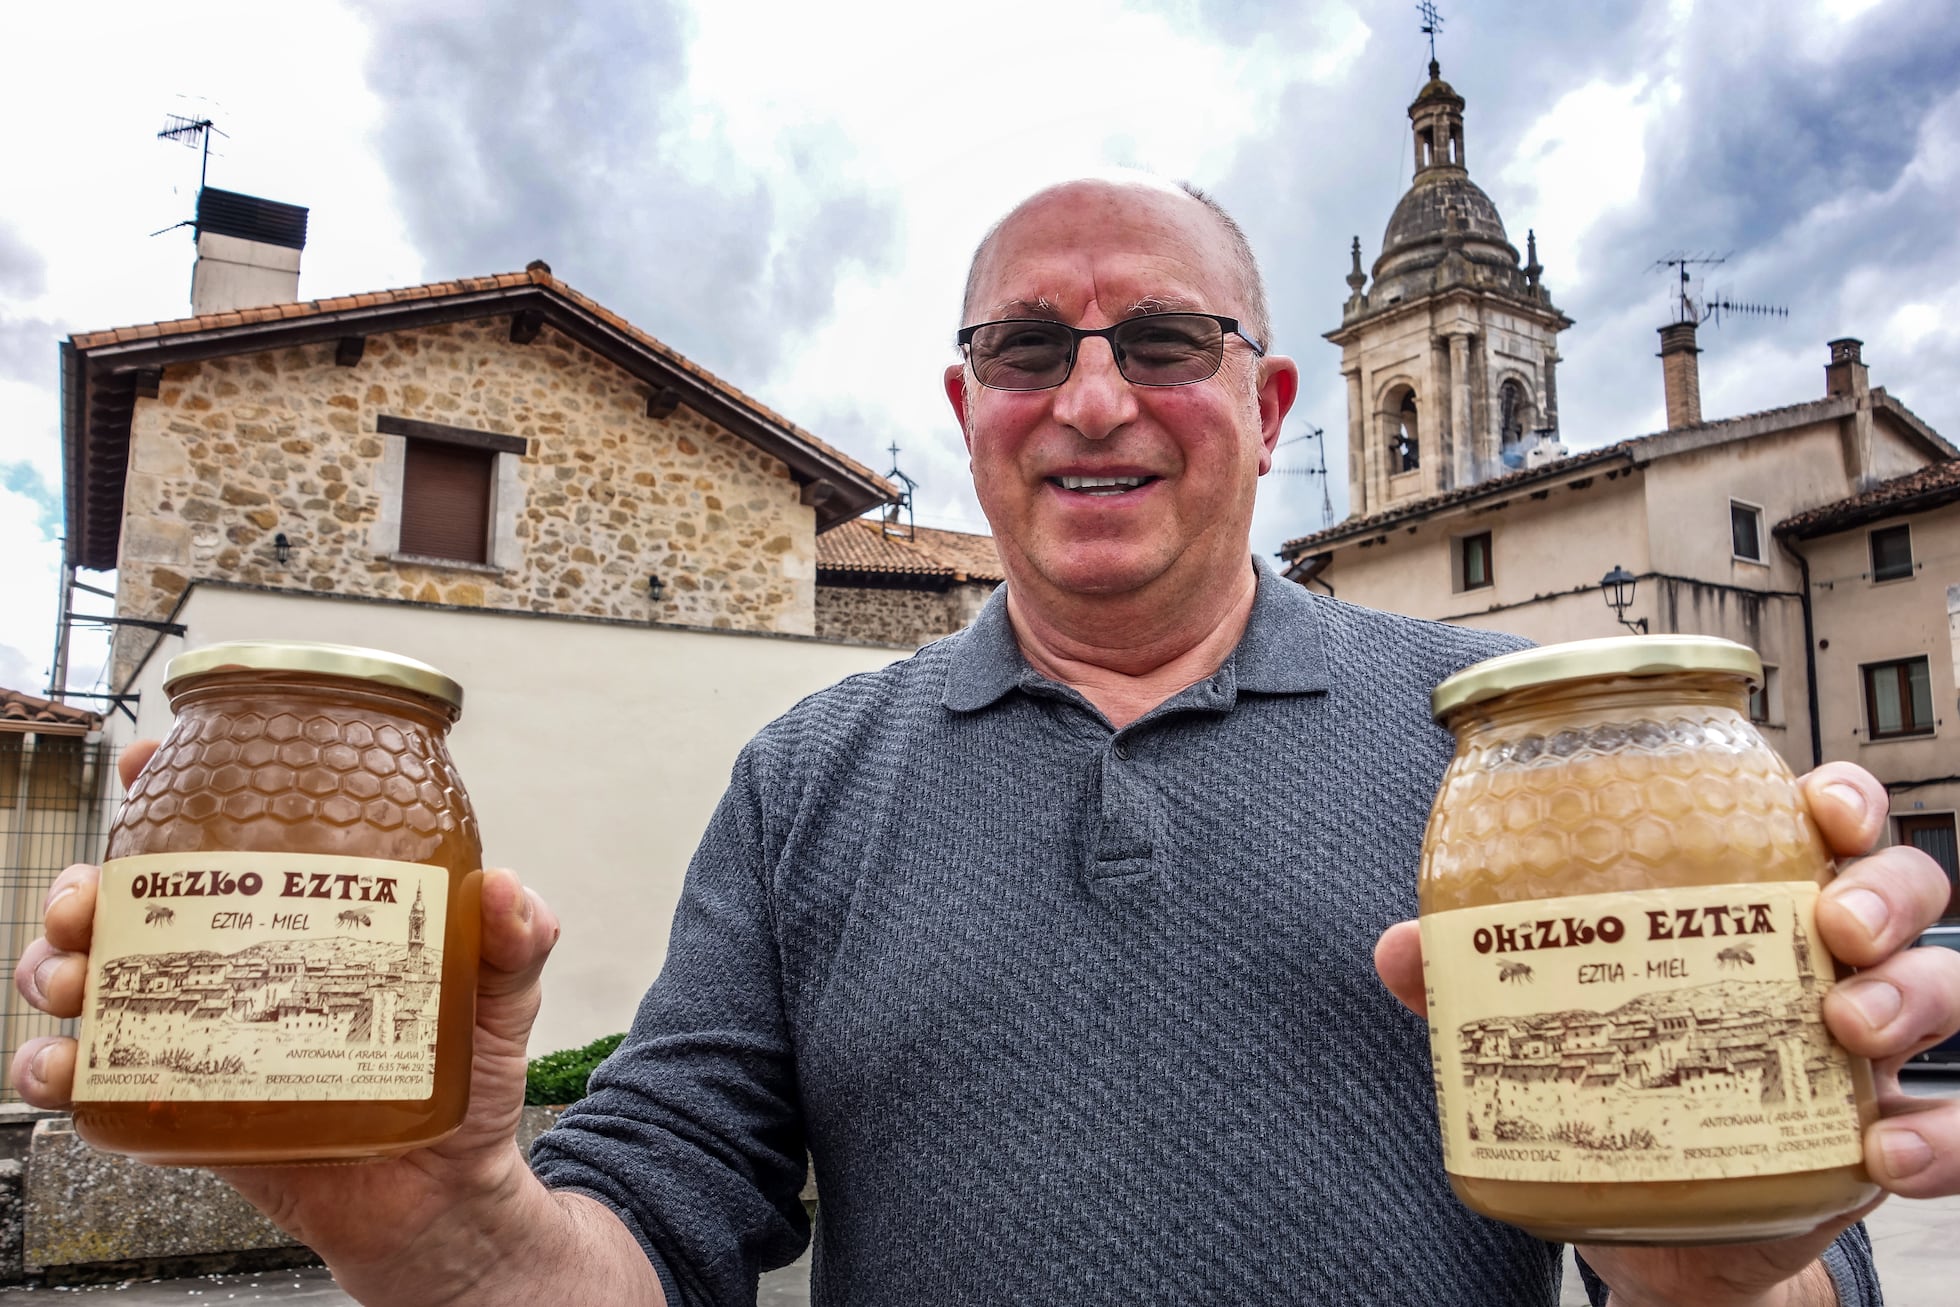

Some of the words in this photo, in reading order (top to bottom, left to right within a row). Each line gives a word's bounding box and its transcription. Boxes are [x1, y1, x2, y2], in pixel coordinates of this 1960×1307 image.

[211, 911, 253, 930] EZTIA
[272, 913, 310, 931] MIEL
[1577, 964, 1625, 985] EZTIA
[1646, 957, 1690, 980] MIEL
[379, 1062, 394, 1072] 635
[411, 1062, 425, 1072] 292
[266, 1074, 316, 1085] BEREZKO
[316, 1074, 343, 1085] UZTA
[351, 1074, 392, 1085] COSECHA
[394, 1075, 424, 1085] PROPIA
[1531, 1149, 1561, 1162] DIAZ
